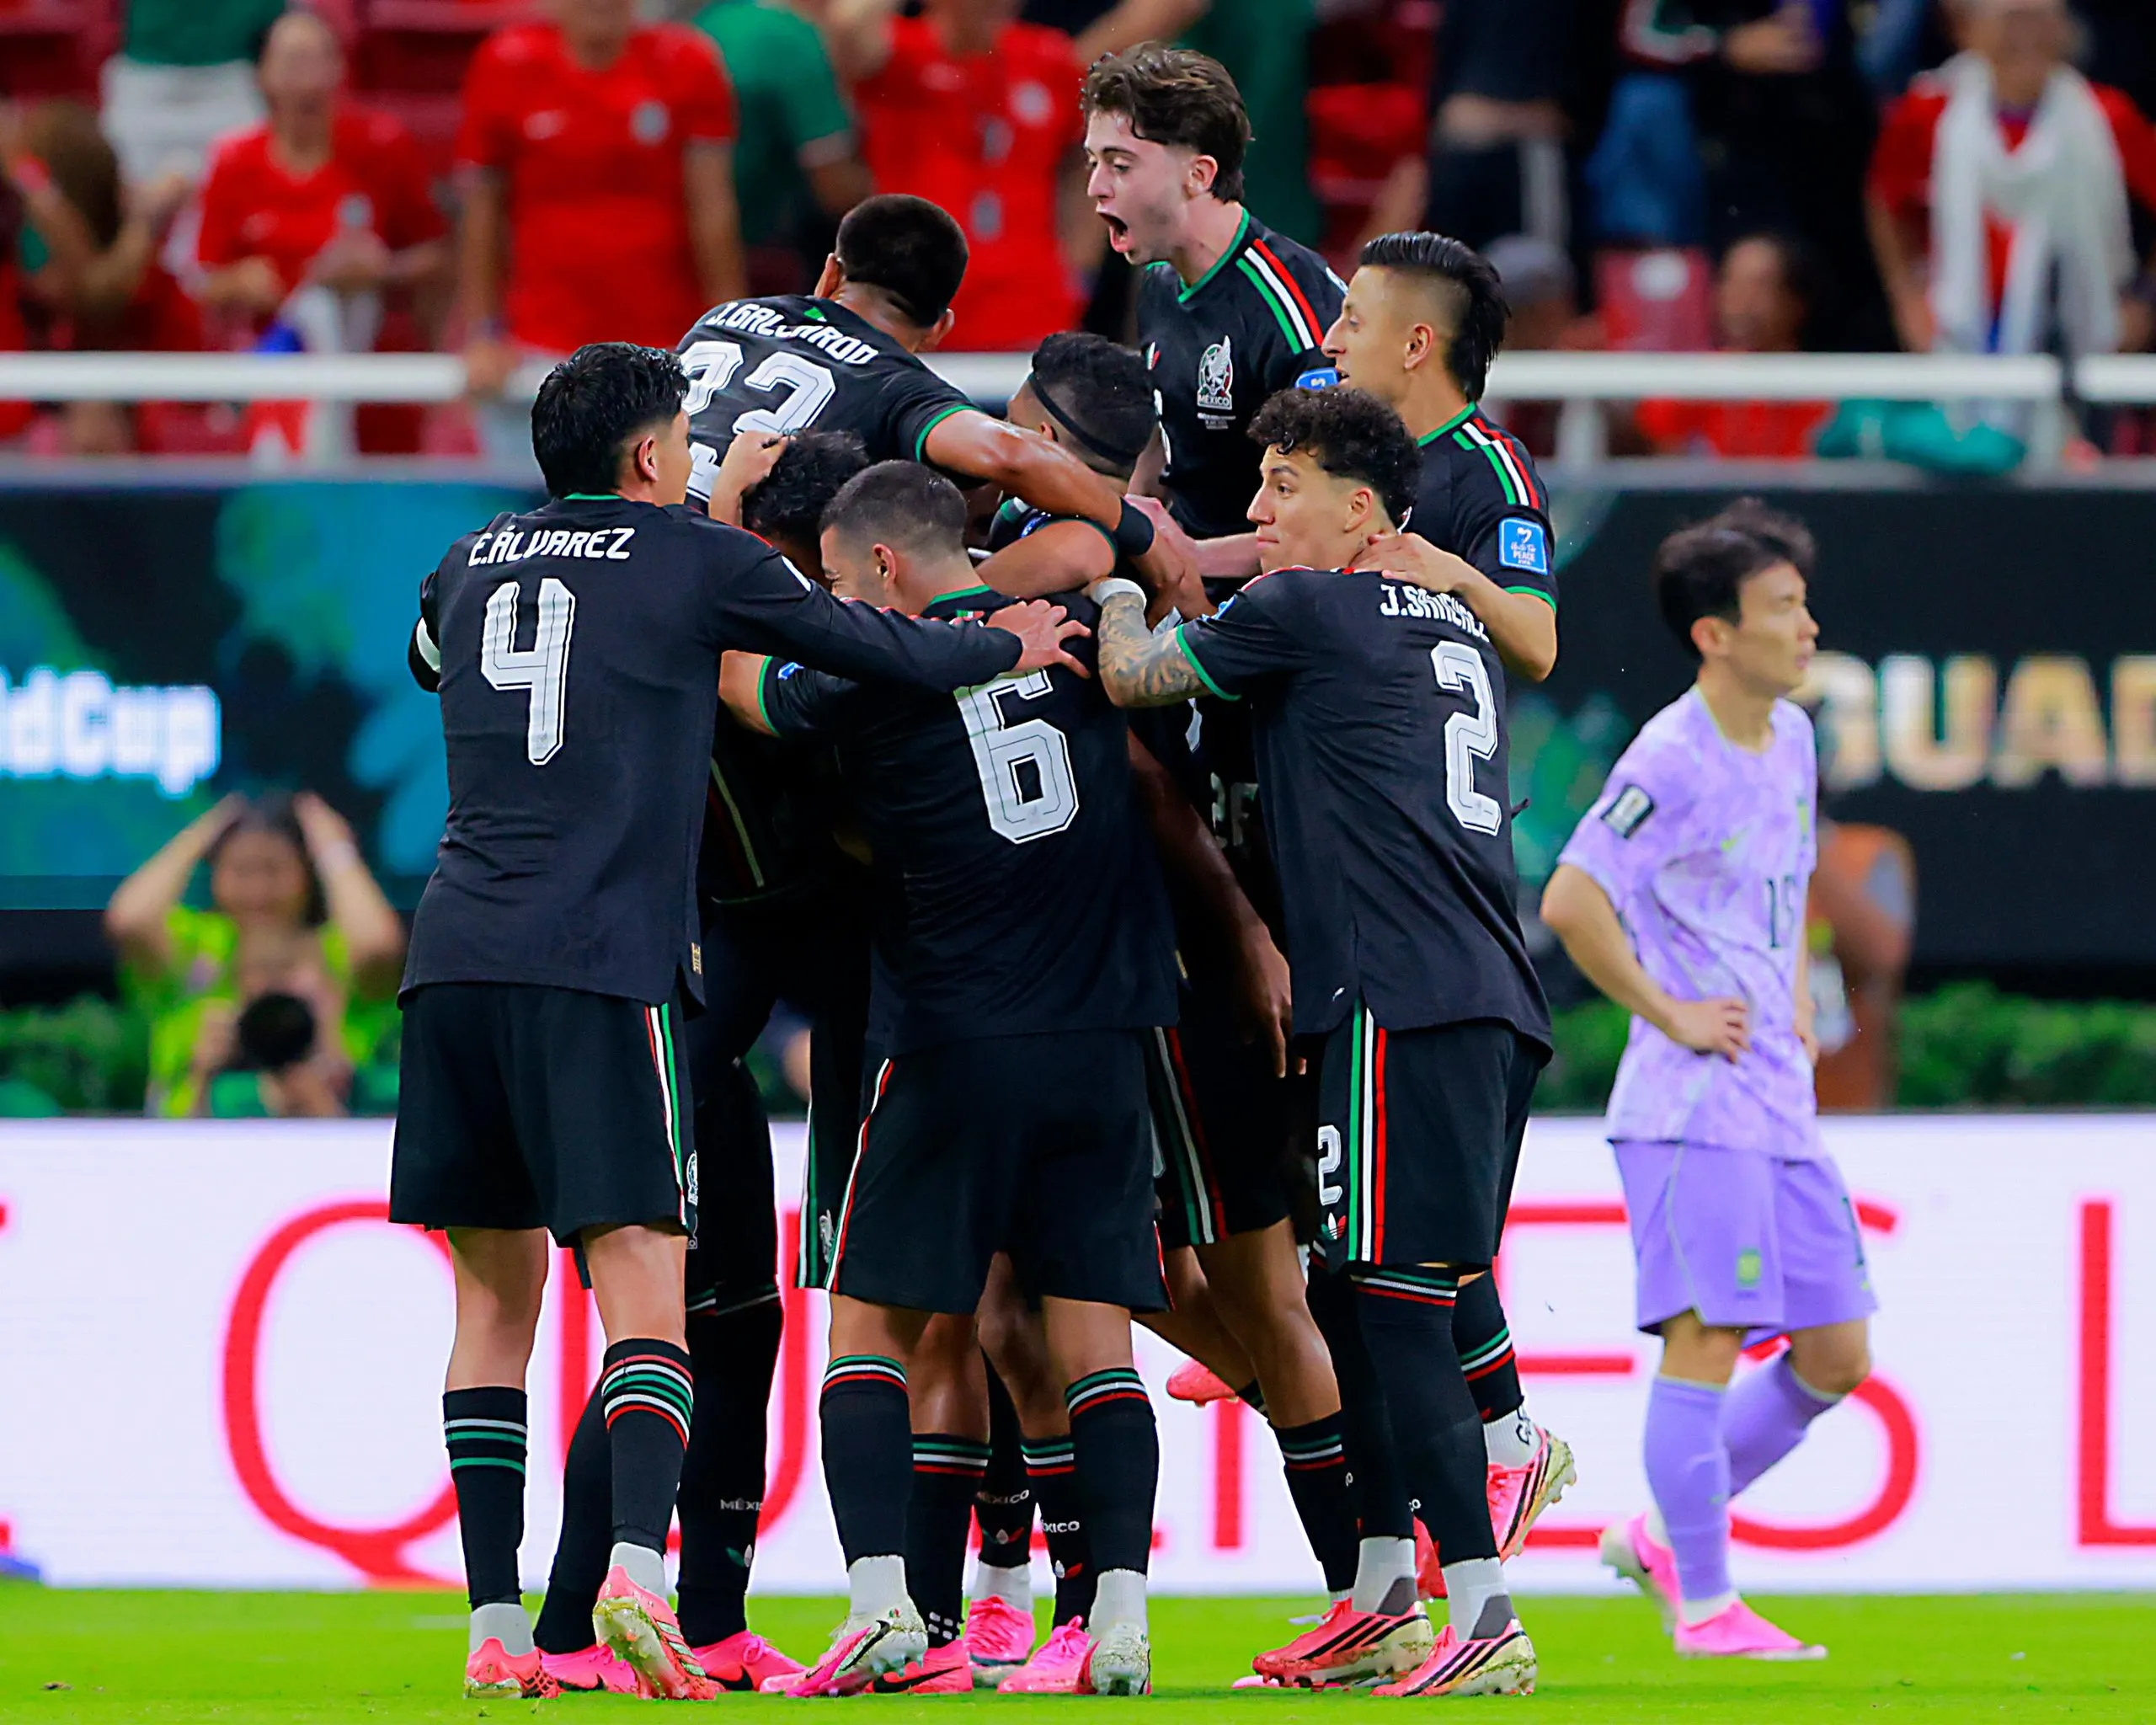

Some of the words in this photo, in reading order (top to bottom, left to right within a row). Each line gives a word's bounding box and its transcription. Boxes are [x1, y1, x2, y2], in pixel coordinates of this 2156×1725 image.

[468, 525, 635, 567] E.ÁLVAREZ
[481, 578, 576, 766] 4
[953, 667, 1080, 845] 6
[1431, 640, 1502, 836] 2
[1318, 1124, 1342, 1206] 2
